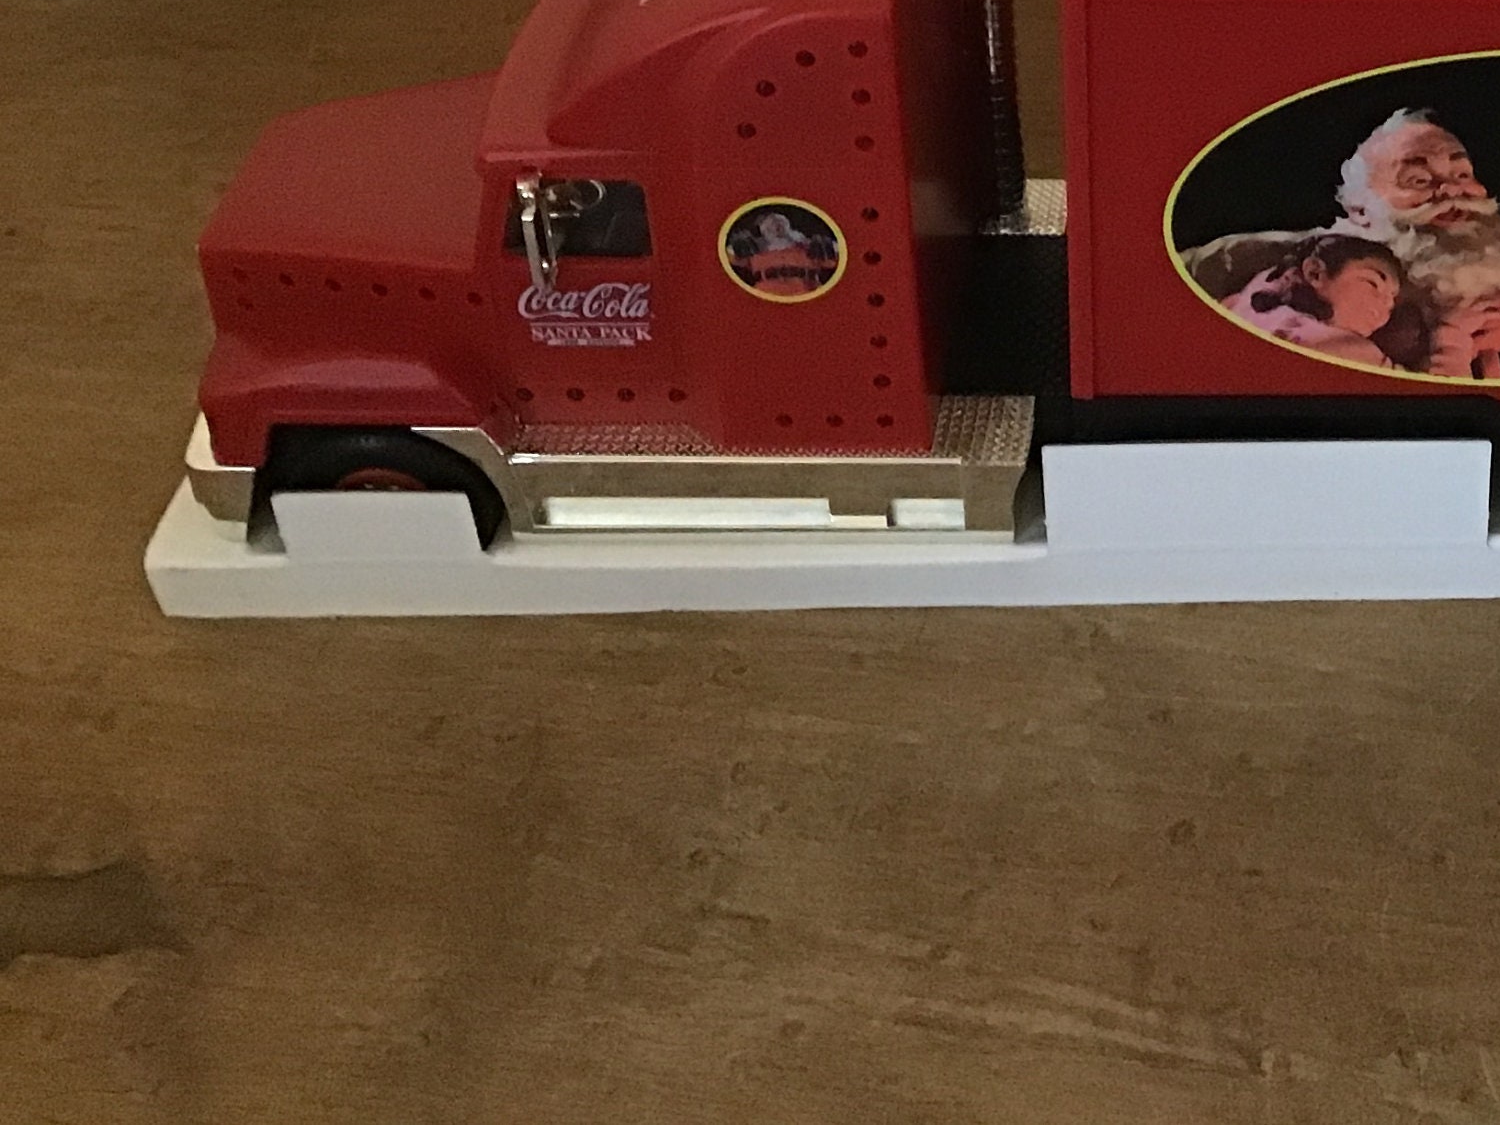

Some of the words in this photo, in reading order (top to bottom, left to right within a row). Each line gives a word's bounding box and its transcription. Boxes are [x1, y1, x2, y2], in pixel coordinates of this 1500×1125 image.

[517, 282, 651, 319] Coca-Cola
[531, 327, 592, 342] SANTA
[599, 326, 653, 342] PACK
